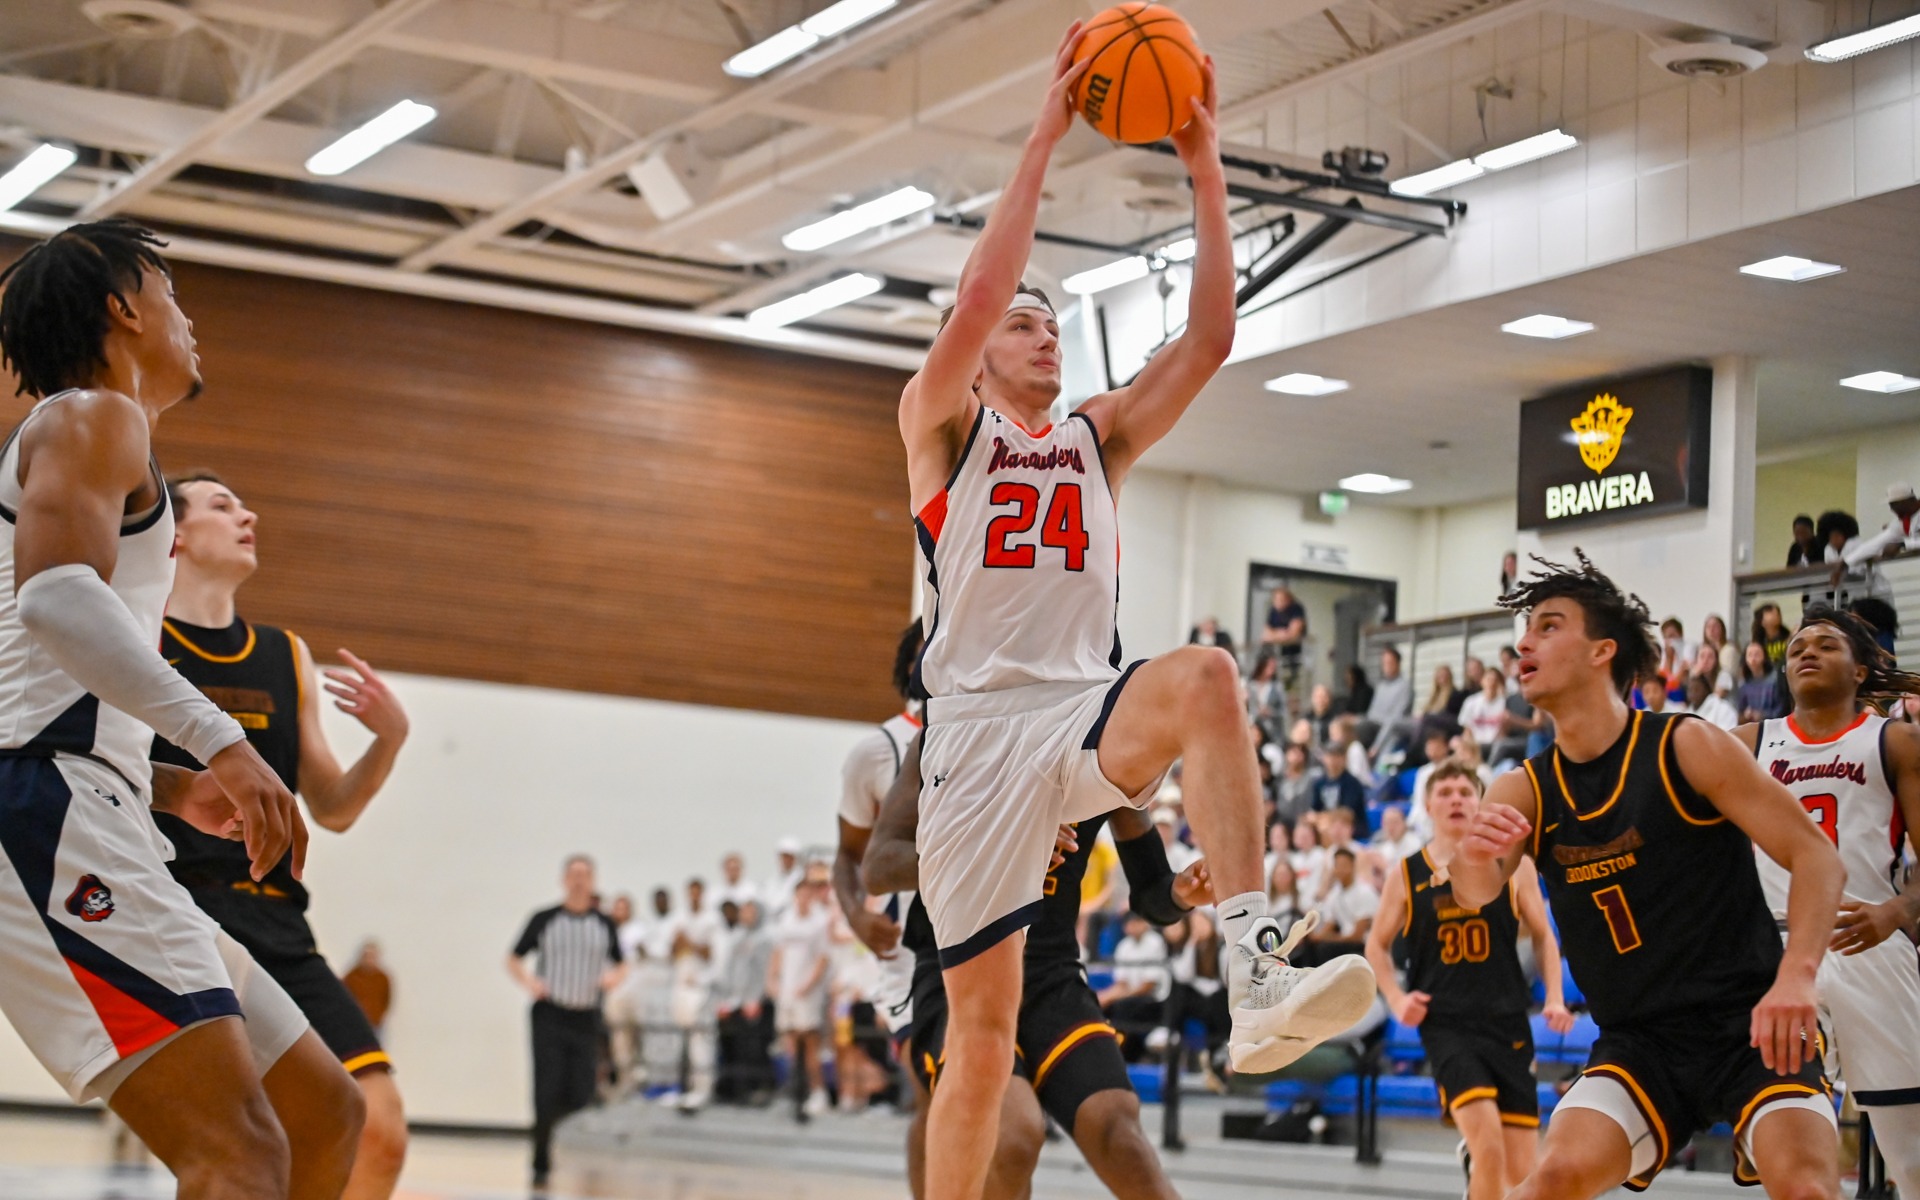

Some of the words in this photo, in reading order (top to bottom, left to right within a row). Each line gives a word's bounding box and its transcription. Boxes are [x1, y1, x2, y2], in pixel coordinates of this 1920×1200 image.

[987, 436, 1085, 475] Marauders
[1545, 471, 1654, 519] BRAVERA
[983, 481, 1089, 572] 24
[1769, 754, 1866, 785] Marauders
[1437, 918, 1490, 965] 30
[1592, 884, 1642, 954] 1
